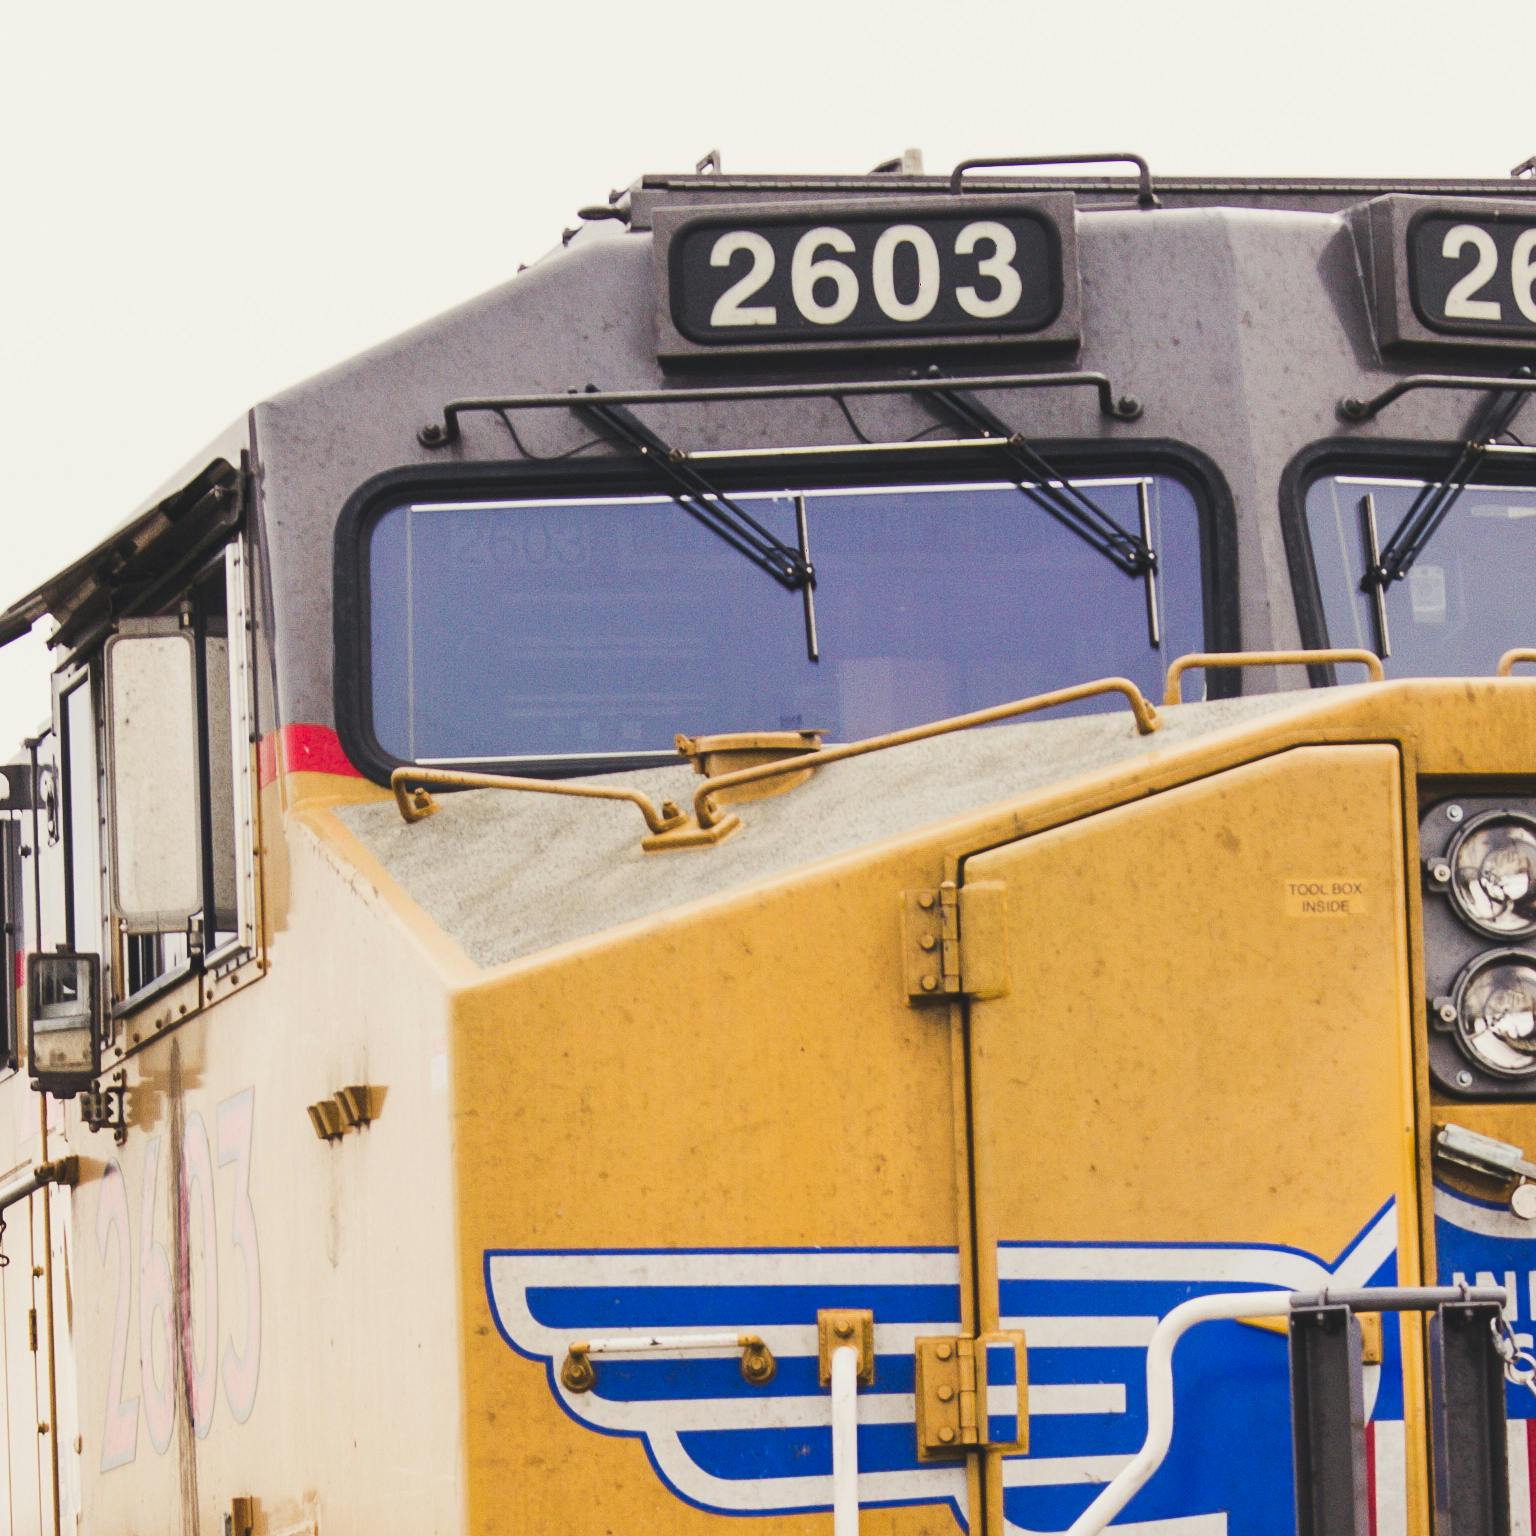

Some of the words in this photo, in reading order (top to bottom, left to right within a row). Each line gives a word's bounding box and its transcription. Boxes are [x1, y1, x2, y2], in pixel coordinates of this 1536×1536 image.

[709, 220, 1023, 328] 2603
[1287, 883, 1328, 896] TOOL
[1331, 882, 1363, 895] BOX
[1301, 900, 1350, 913] INSIDE
[95, 1084, 263, 1474] 2603
